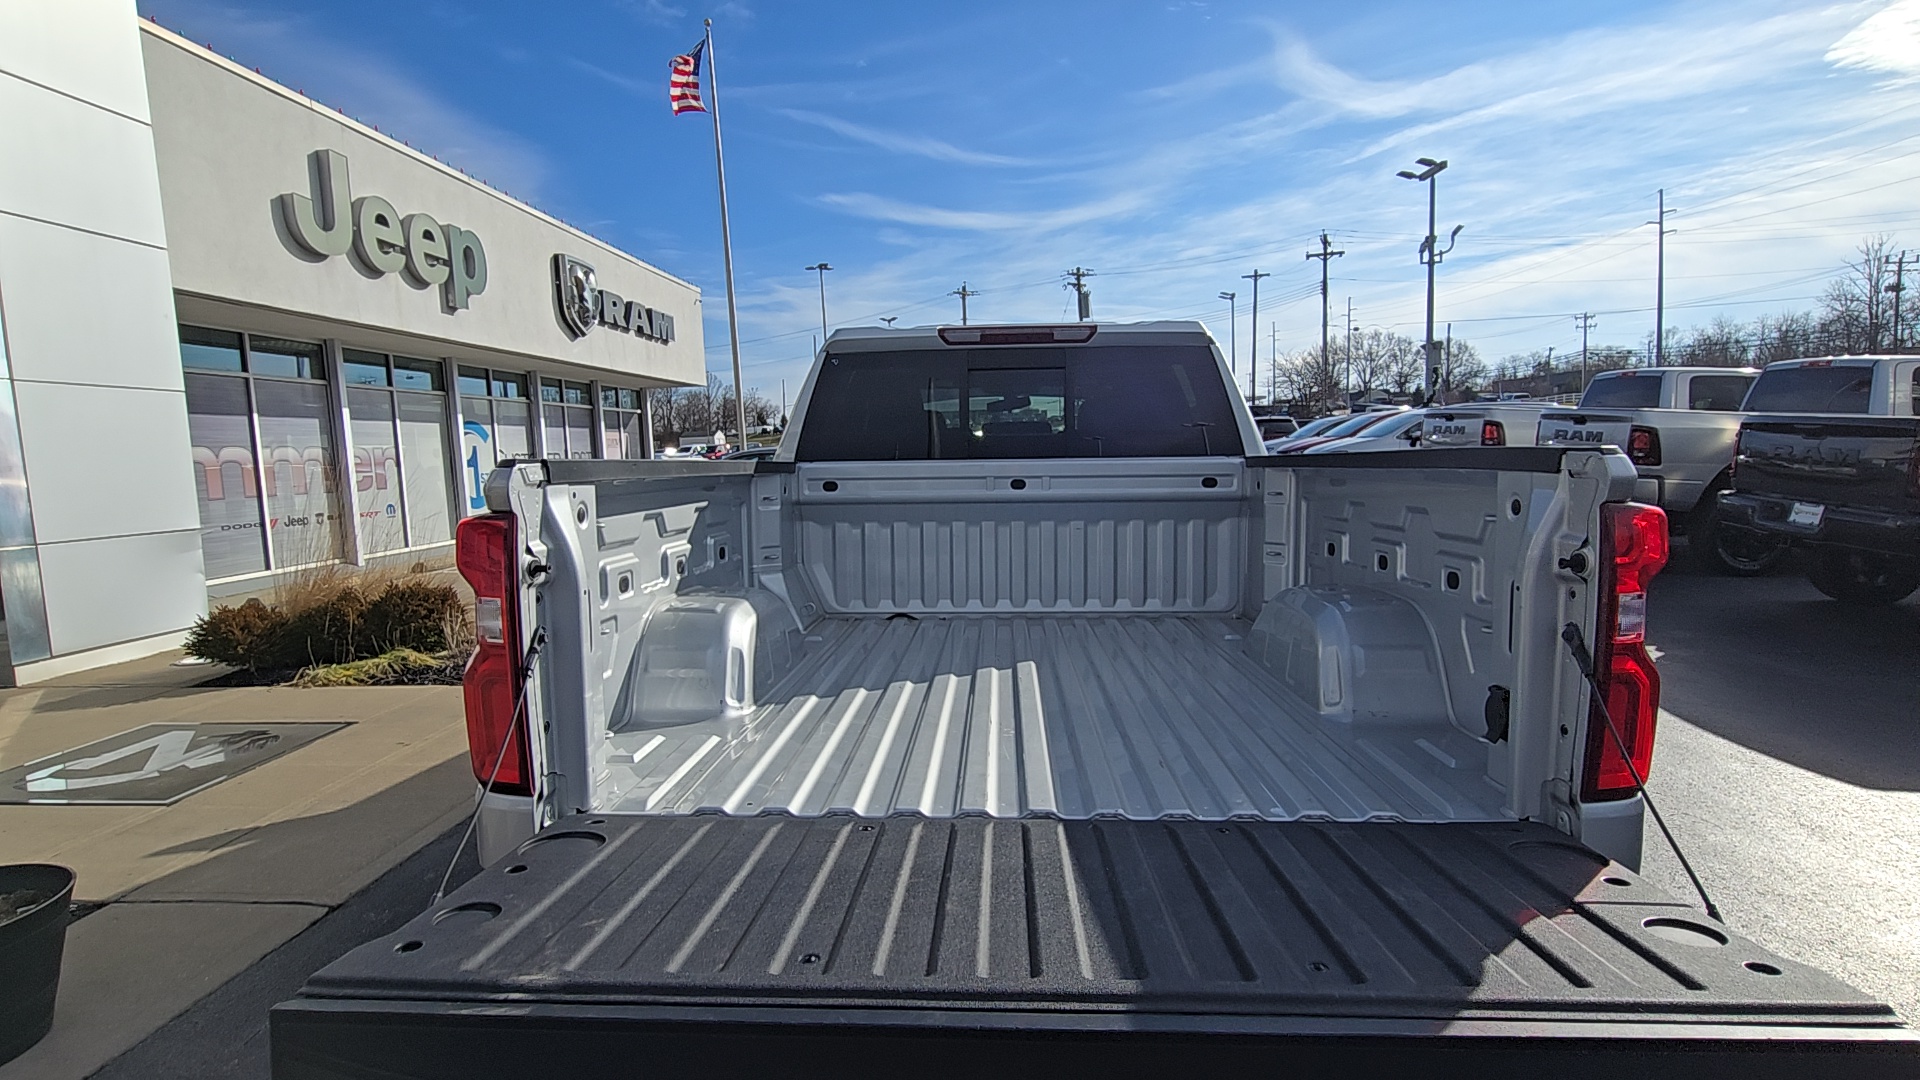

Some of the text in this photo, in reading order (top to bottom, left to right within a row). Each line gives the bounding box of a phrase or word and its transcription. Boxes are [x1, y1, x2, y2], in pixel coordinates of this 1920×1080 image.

[270, 149, 488, 316] Jeep
[598, 289, 675, 346] RAM
[1432, 425, 1466, 435] RAM
[1554, 429, 1604, 442] RAM
[1769, 443, 1862, 464] RAM
[283, 515, 309, 528] Jeep
